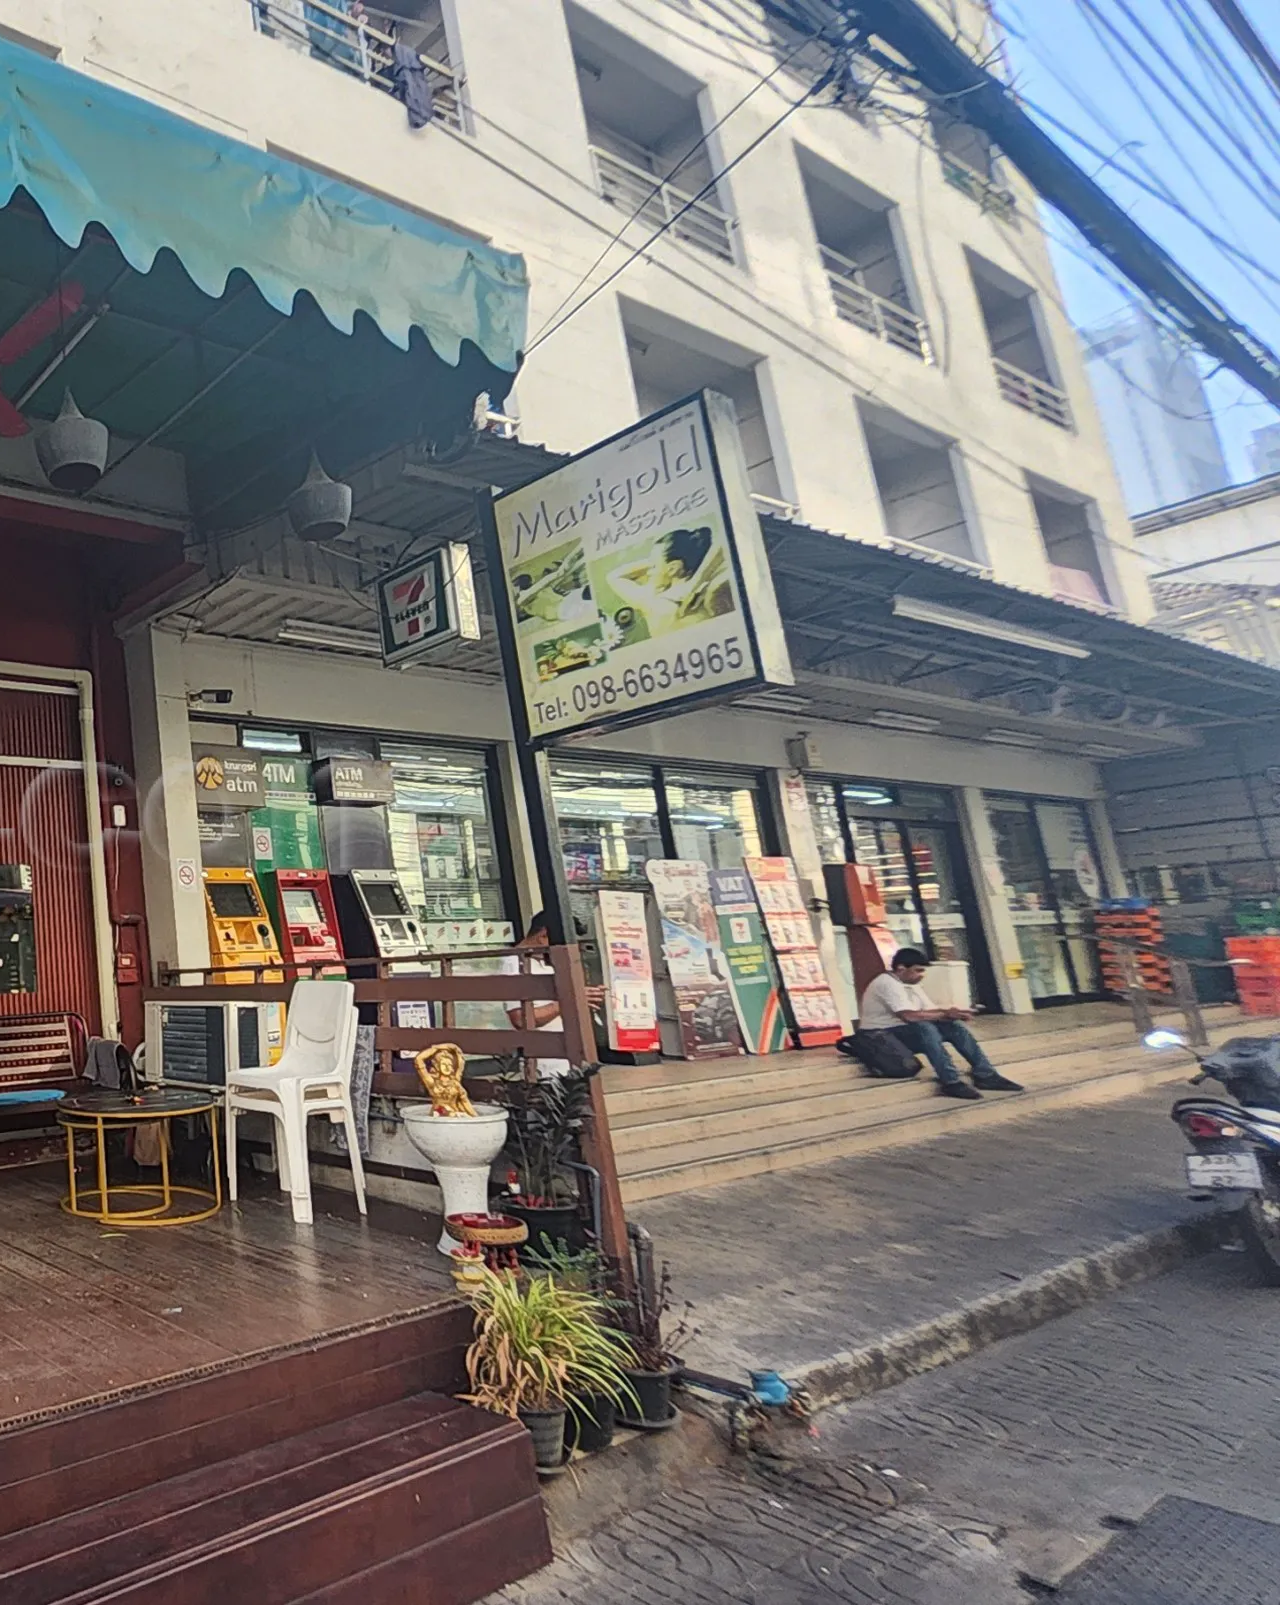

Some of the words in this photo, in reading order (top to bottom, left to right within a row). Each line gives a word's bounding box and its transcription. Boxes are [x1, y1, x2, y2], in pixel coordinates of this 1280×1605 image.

[513, 424, 702, 559] Marigold
[596, 487, 708, 551] MASSAGE
[534, 697, 568, 724] Tel:
[572, 636, 743, 713] 098-6634965
[226, 777, 257, 792] atm
[335, 767, 363, 780] ATM
